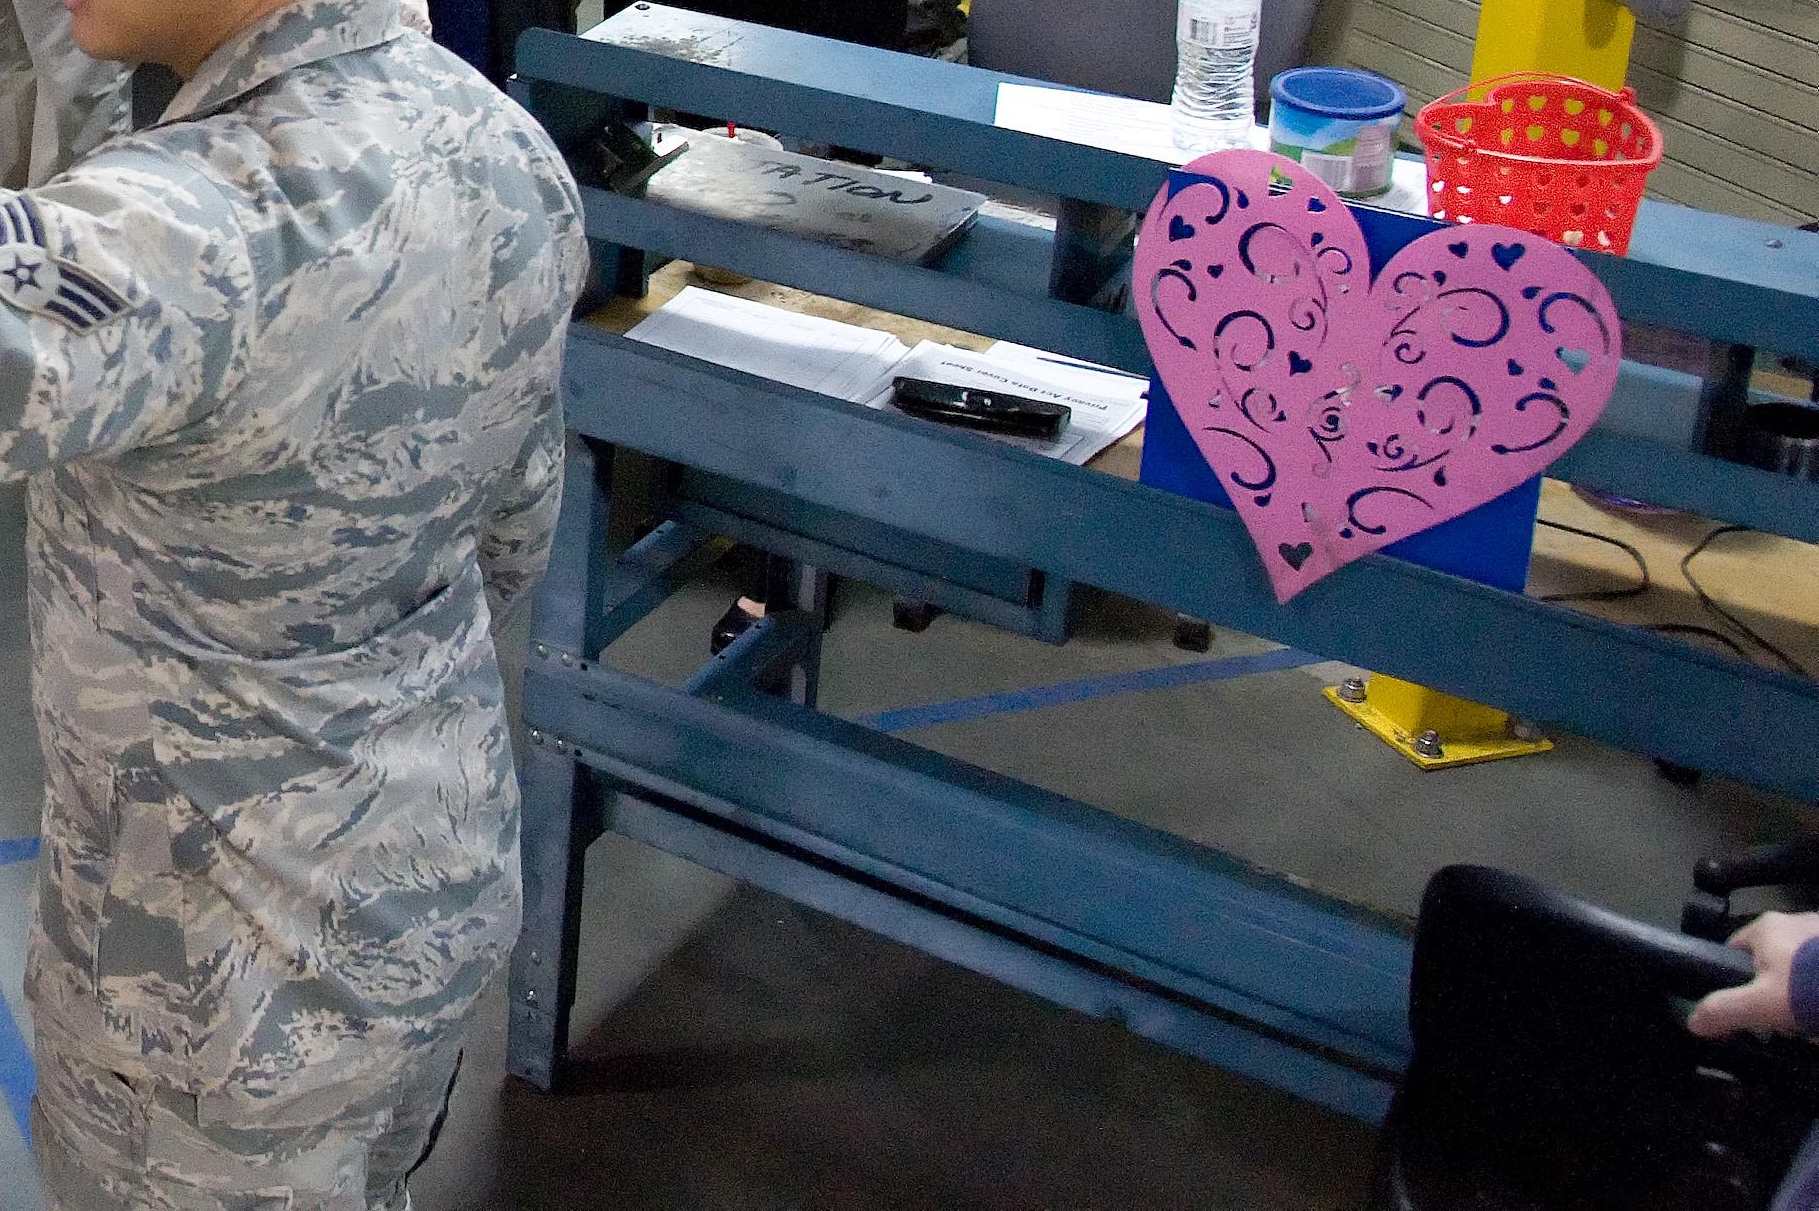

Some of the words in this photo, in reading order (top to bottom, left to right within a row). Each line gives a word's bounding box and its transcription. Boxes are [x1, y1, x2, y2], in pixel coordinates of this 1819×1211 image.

[940, 360, 975, 373] Sheet
[977, 369, 1008, 384] Cover
[1011, 380, 1038, 393] Data
[1041, 389, 1062, 399] Act
[1064, 396, 1108, 411] Privacy
